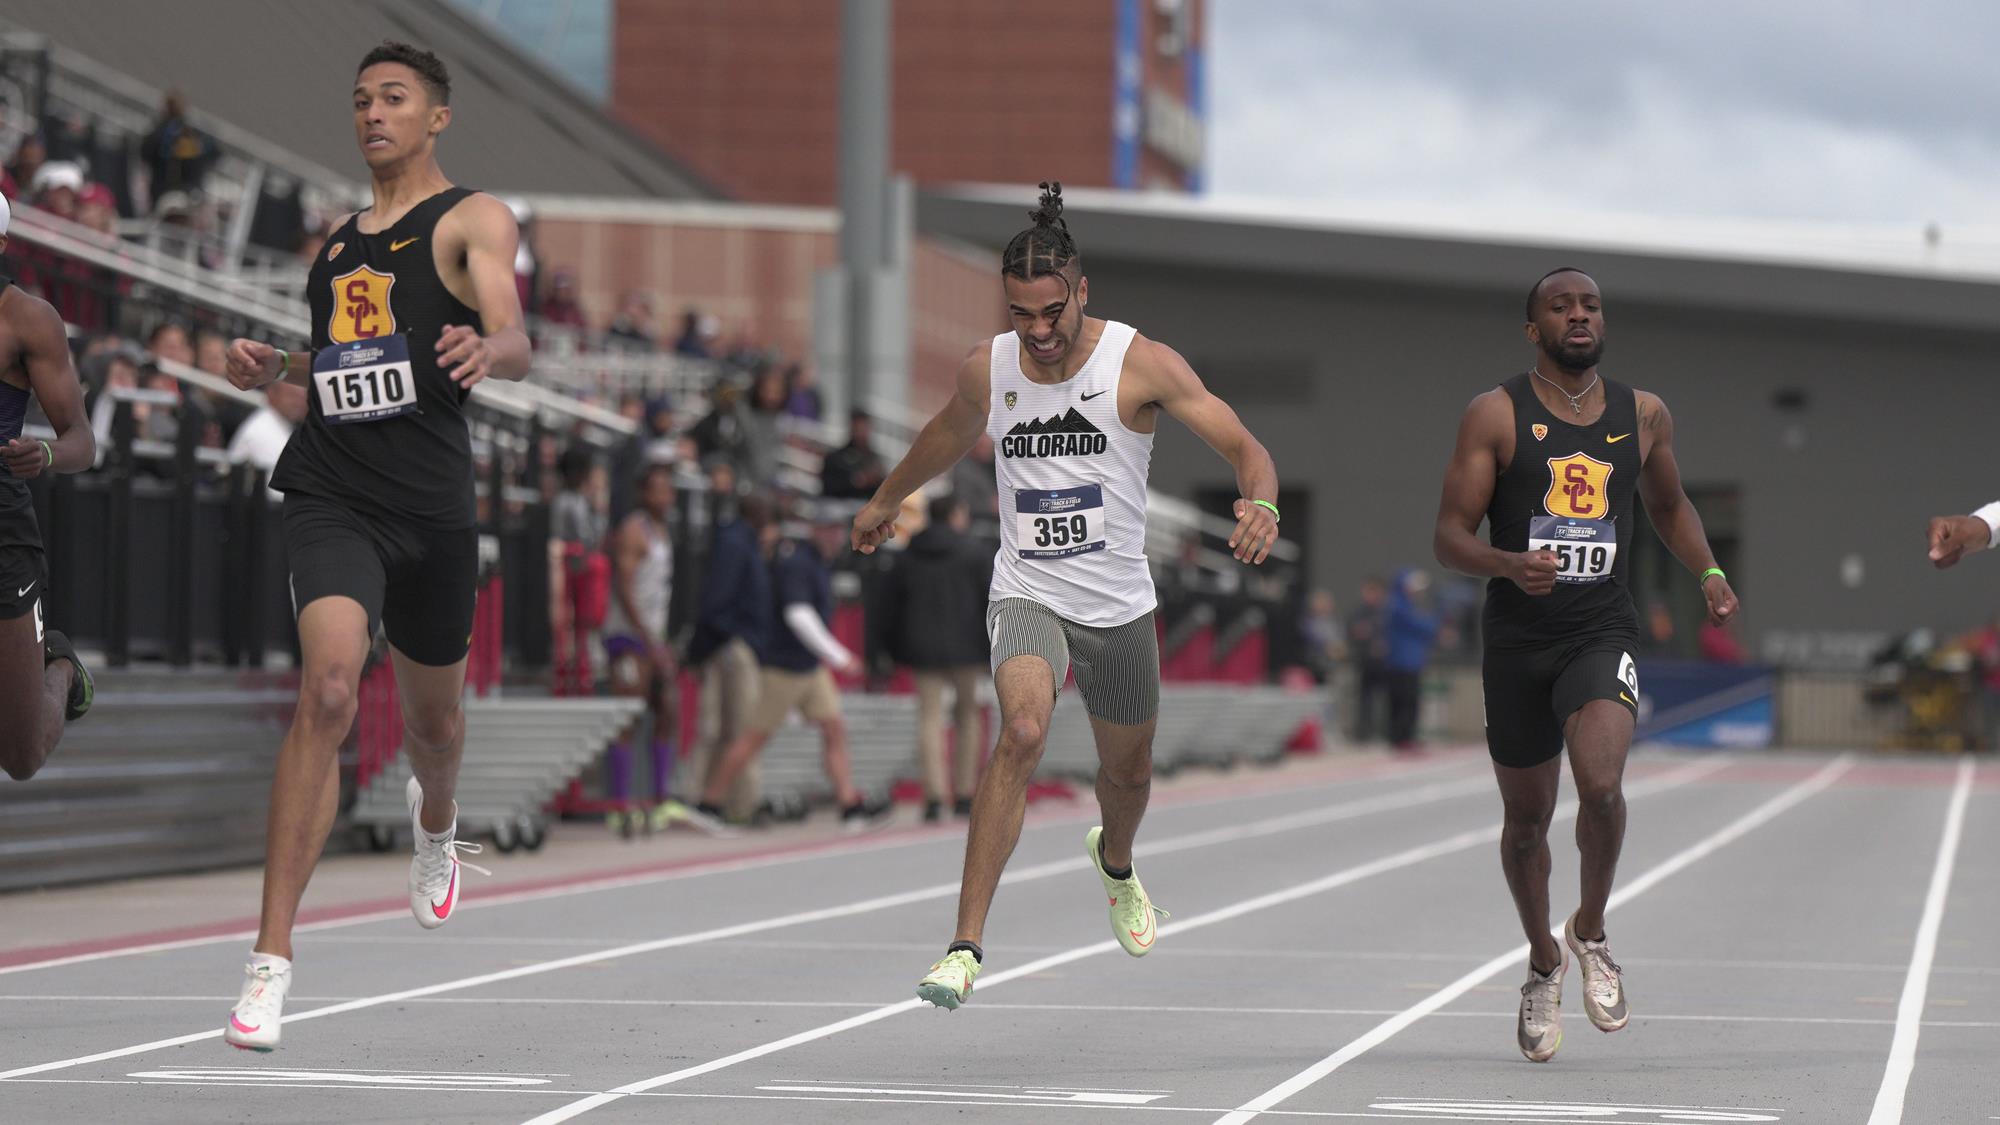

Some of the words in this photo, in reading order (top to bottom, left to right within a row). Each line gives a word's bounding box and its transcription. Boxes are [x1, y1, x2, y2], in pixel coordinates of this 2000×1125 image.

[327, 368, 404, 410] 1510
[1002, 433, 1108, 459] COLORADO
[1033, 514, 1088, 547] 359
[1625, 662, 1637, 692] 6
